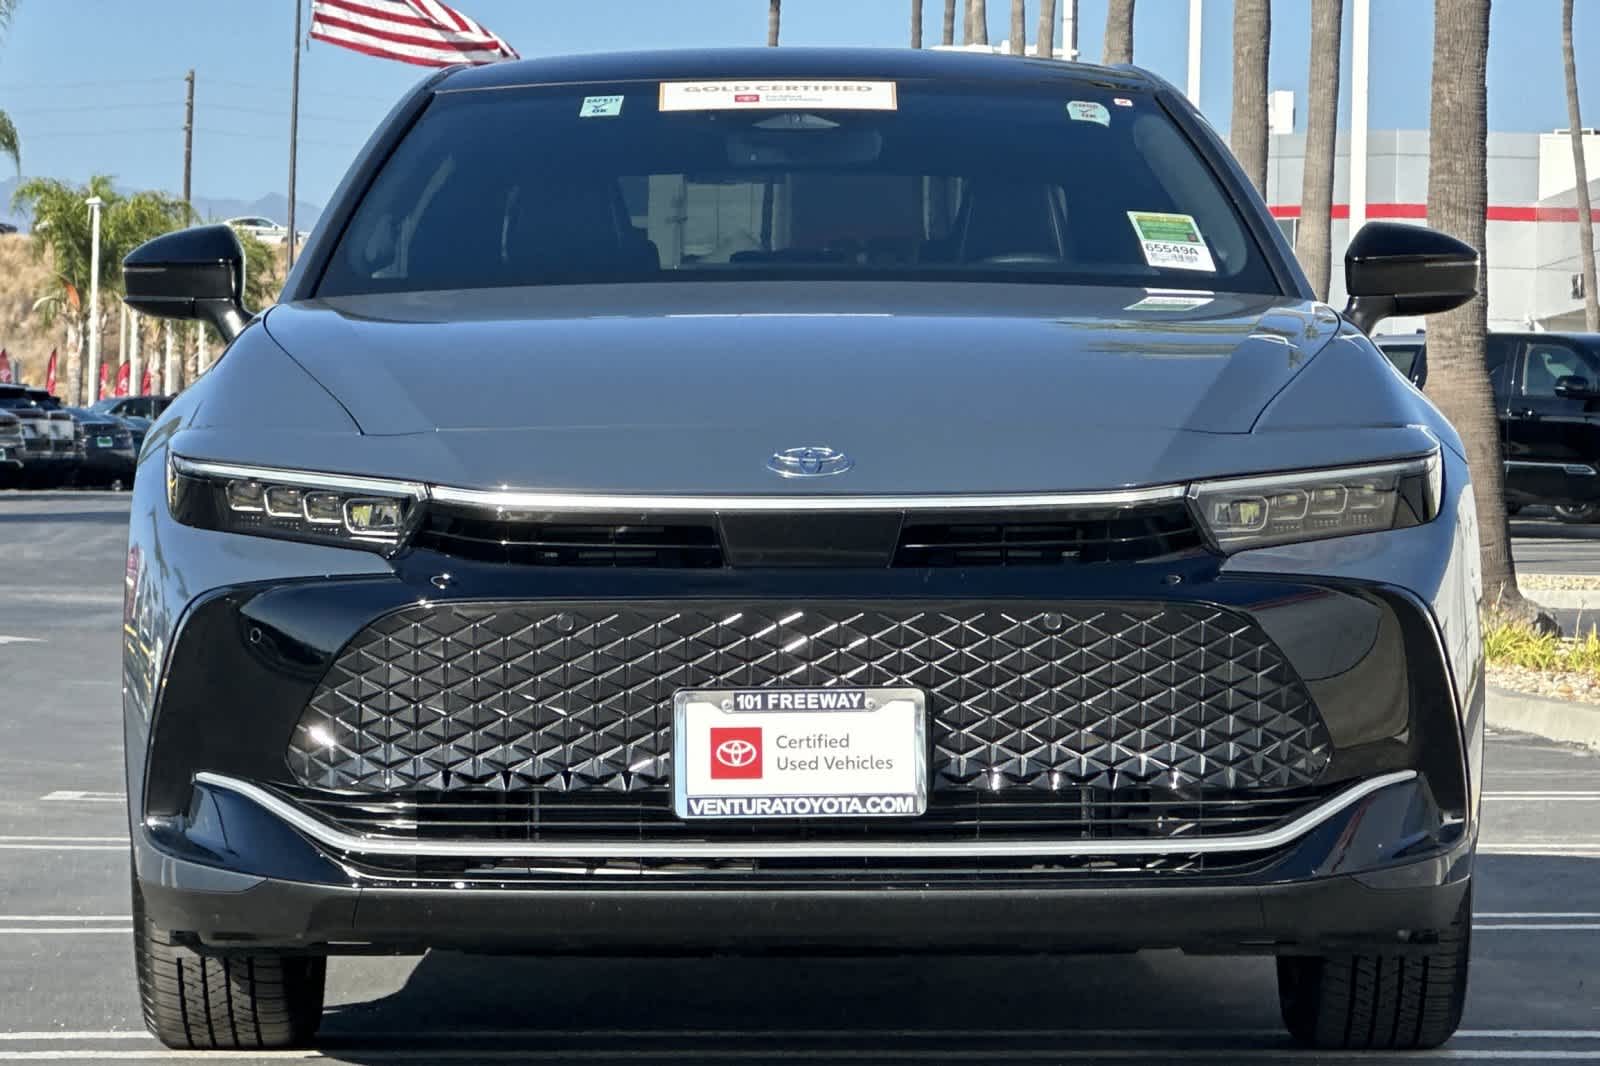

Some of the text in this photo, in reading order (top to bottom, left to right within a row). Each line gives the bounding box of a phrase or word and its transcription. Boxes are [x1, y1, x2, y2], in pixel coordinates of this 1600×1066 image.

[756, 84, 873, 92] CERTIFIED
[1146, 243, 1198, 255] 65549A
[736, 693, 862, 709] 101 FREEWAY
[776, 733, 850, 749] Certified
[776, 755, 893, 771] Used Vehicles
[689, 797, 914, 816] VENTURATOYOTA.COM
